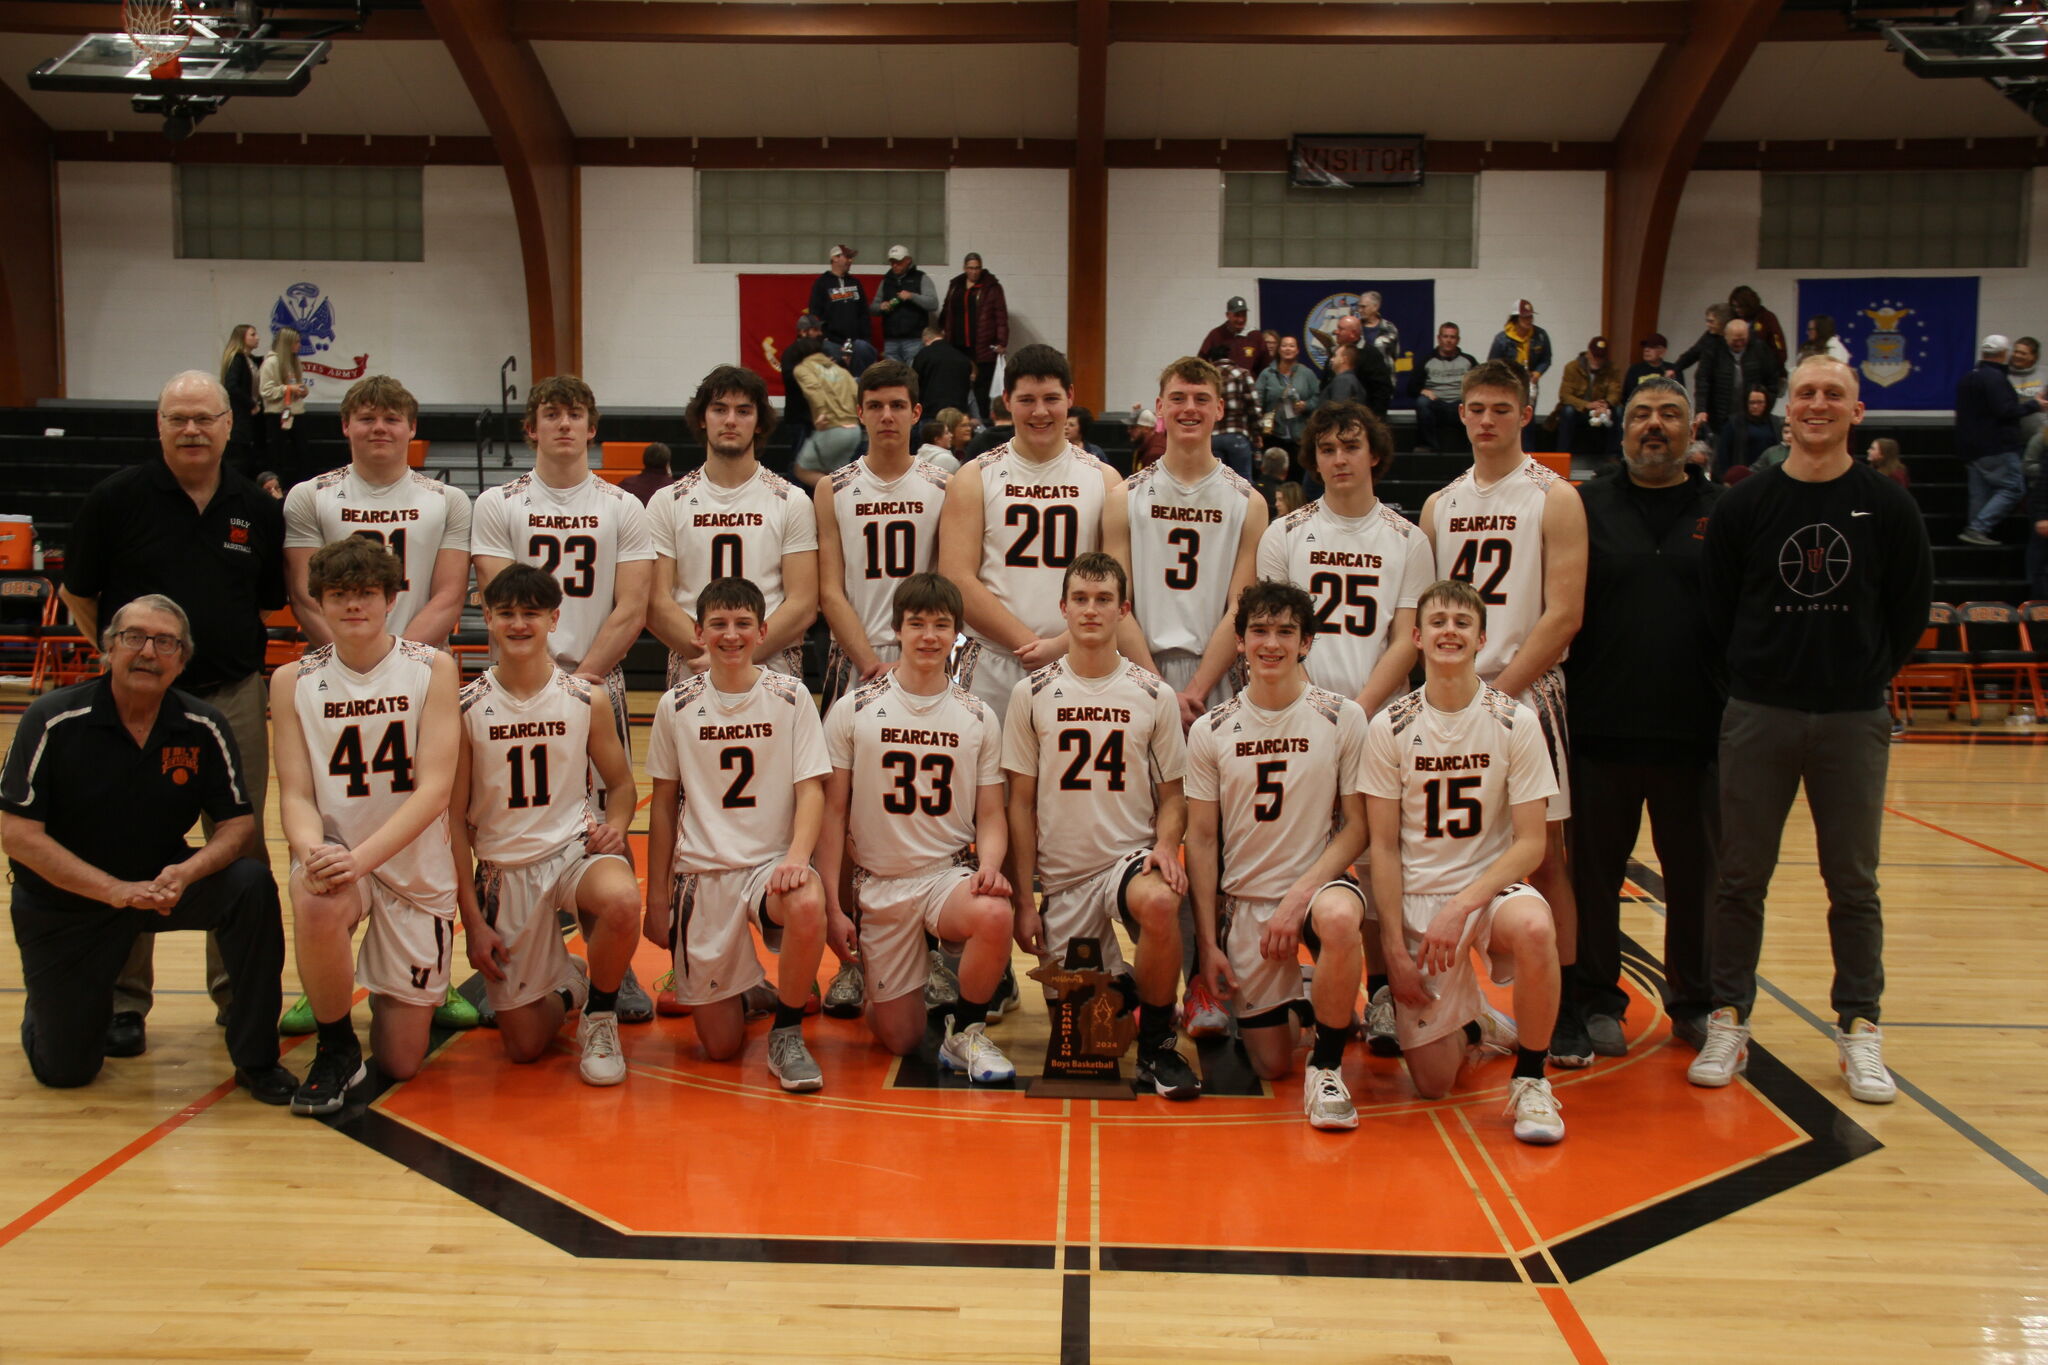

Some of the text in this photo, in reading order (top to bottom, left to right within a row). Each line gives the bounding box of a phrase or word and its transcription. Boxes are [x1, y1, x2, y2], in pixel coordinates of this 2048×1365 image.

[1301, 147, 1419, 173] VISITOR
[1005, 484, 1080, 499] BEARCATS
[341, 508, 420, 524] BEARCATS
[855, 501, 924, 516] BEARCATS
[1151, 505, 1223, 524] BEARCATS
[229, 517, 252, 529] UBLY
[528, 513, 599, 529] BEARCATS
[693, 513, 763, 527] BEARCATS
[1449, 515, 1518, 533] BEARCATS
[1004, 503, 1079, 569] 20
[223, 541, 253, 553] BASKETBALL
[863, 520, 916, 580] 10
[528, 534, 598, 599] 23
[1165, 527, 1201, 591] 3
[1310, 551, 1382, 569] BEARCATS
[1449, 538, 1513, 606] 42
[1, 581, 42, 597] UBLY
[1309, 571, 1379, 637] 25
[1774, 603, 1850, 613] BEARCATS
[324, 695, 409, 719] BEARCATS
[1057, 707, 1131, 724] BEARCATS
[489, 721, 566, 741] BEARCATS
[699, 723, 773, 741] BEARCATS
[881, 728, 959, 748] BEARCATS
[1235, 738, 1309, 757] BEARCATS
[328, 720, 415, 798] 44
[1058, 728, 1126, 792] 24
[1415, 753, 1490, 772] BEARCATS
[506, 743, 552, 809] 11
[720, 746, 756, 809] 2
[882, 750, 954, 817] 33
[1253, 759, 1288, 822] 5
[1423, 776, 1482, 839] 15
[1061, 1003, 1073, 1056] CHAMPION
[1051, 1059, 1114, 1069] Boys Basketball
